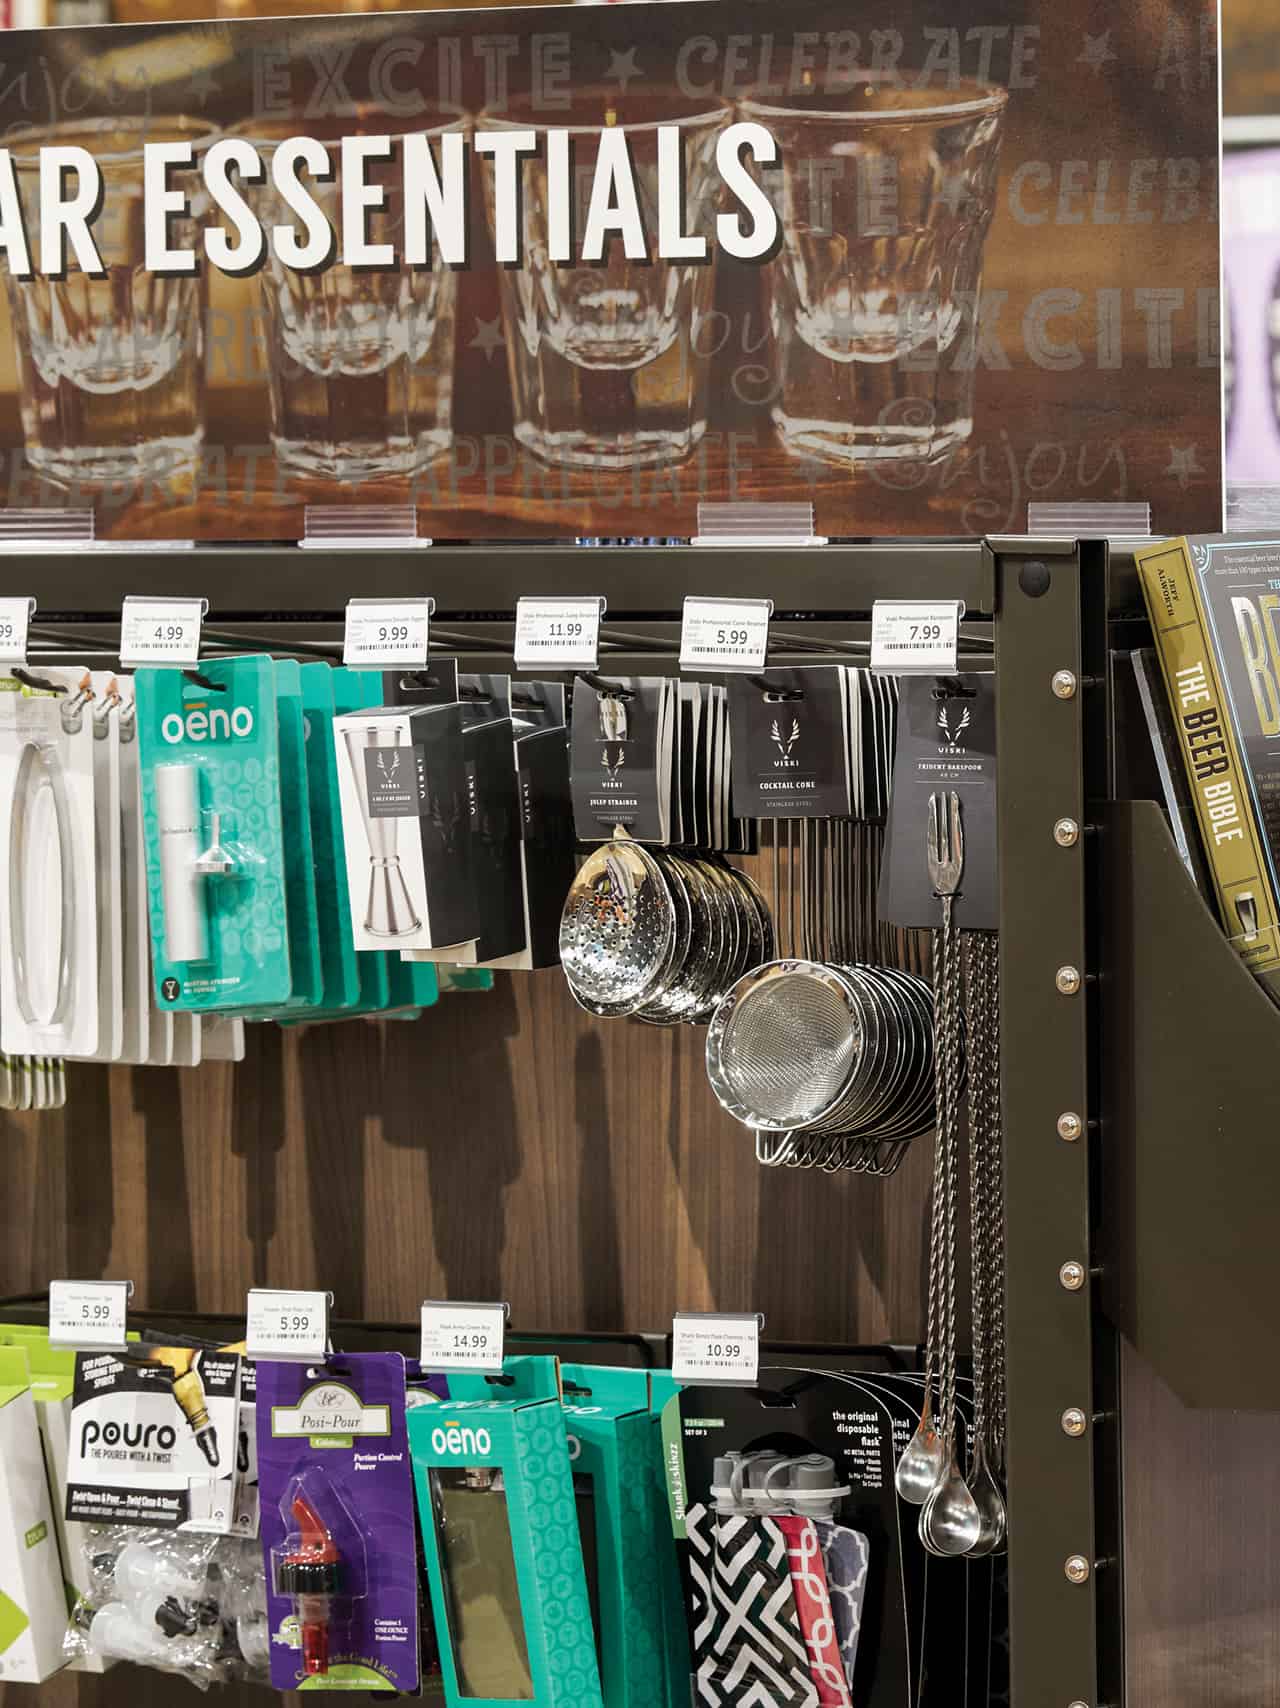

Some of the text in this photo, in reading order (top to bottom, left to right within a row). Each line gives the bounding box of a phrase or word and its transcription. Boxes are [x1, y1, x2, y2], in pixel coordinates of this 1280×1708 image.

[675, 24, 1041, 99] CELEBRATE
[252, 31, 573, 121] EXCITE
[143, 121, 782, 274] ESSENTIALS
[1007, 157, 1219, 226] CELEB
[1156, 568, 1175, 617] ALWORTH
[154, 626, 183, 640] 4.99
[379, 626, 408, 641] 9.99
[549, 623, 582, 636] 11.99
[910, 625, 941, 640] 7.99
[717, 630, 748, 645] 5.99
[1175, 660, 1244, 847] THE BEER BIBLE
[774, 759, 799, 767] VISKI
[759, 780, 816, 790] COCKTAIL CONE
[82, 1304, 110, 1319] 5.99
[280, 1316, 309, 1330] 5.99
[453, 1335, 487, 1348] 14.99
[706, 1344, 740, 1357] 10.99
[832, 1410, 879, 1423] the original
[836, 1423, 879, 1435] disposable
[80, 1420, 177, 1459] pouro
[861, 1435, 881, 1447] flask
[102, 1449, 128, 1460] POURER
[152, 1452, 172, 1464] TWIST
